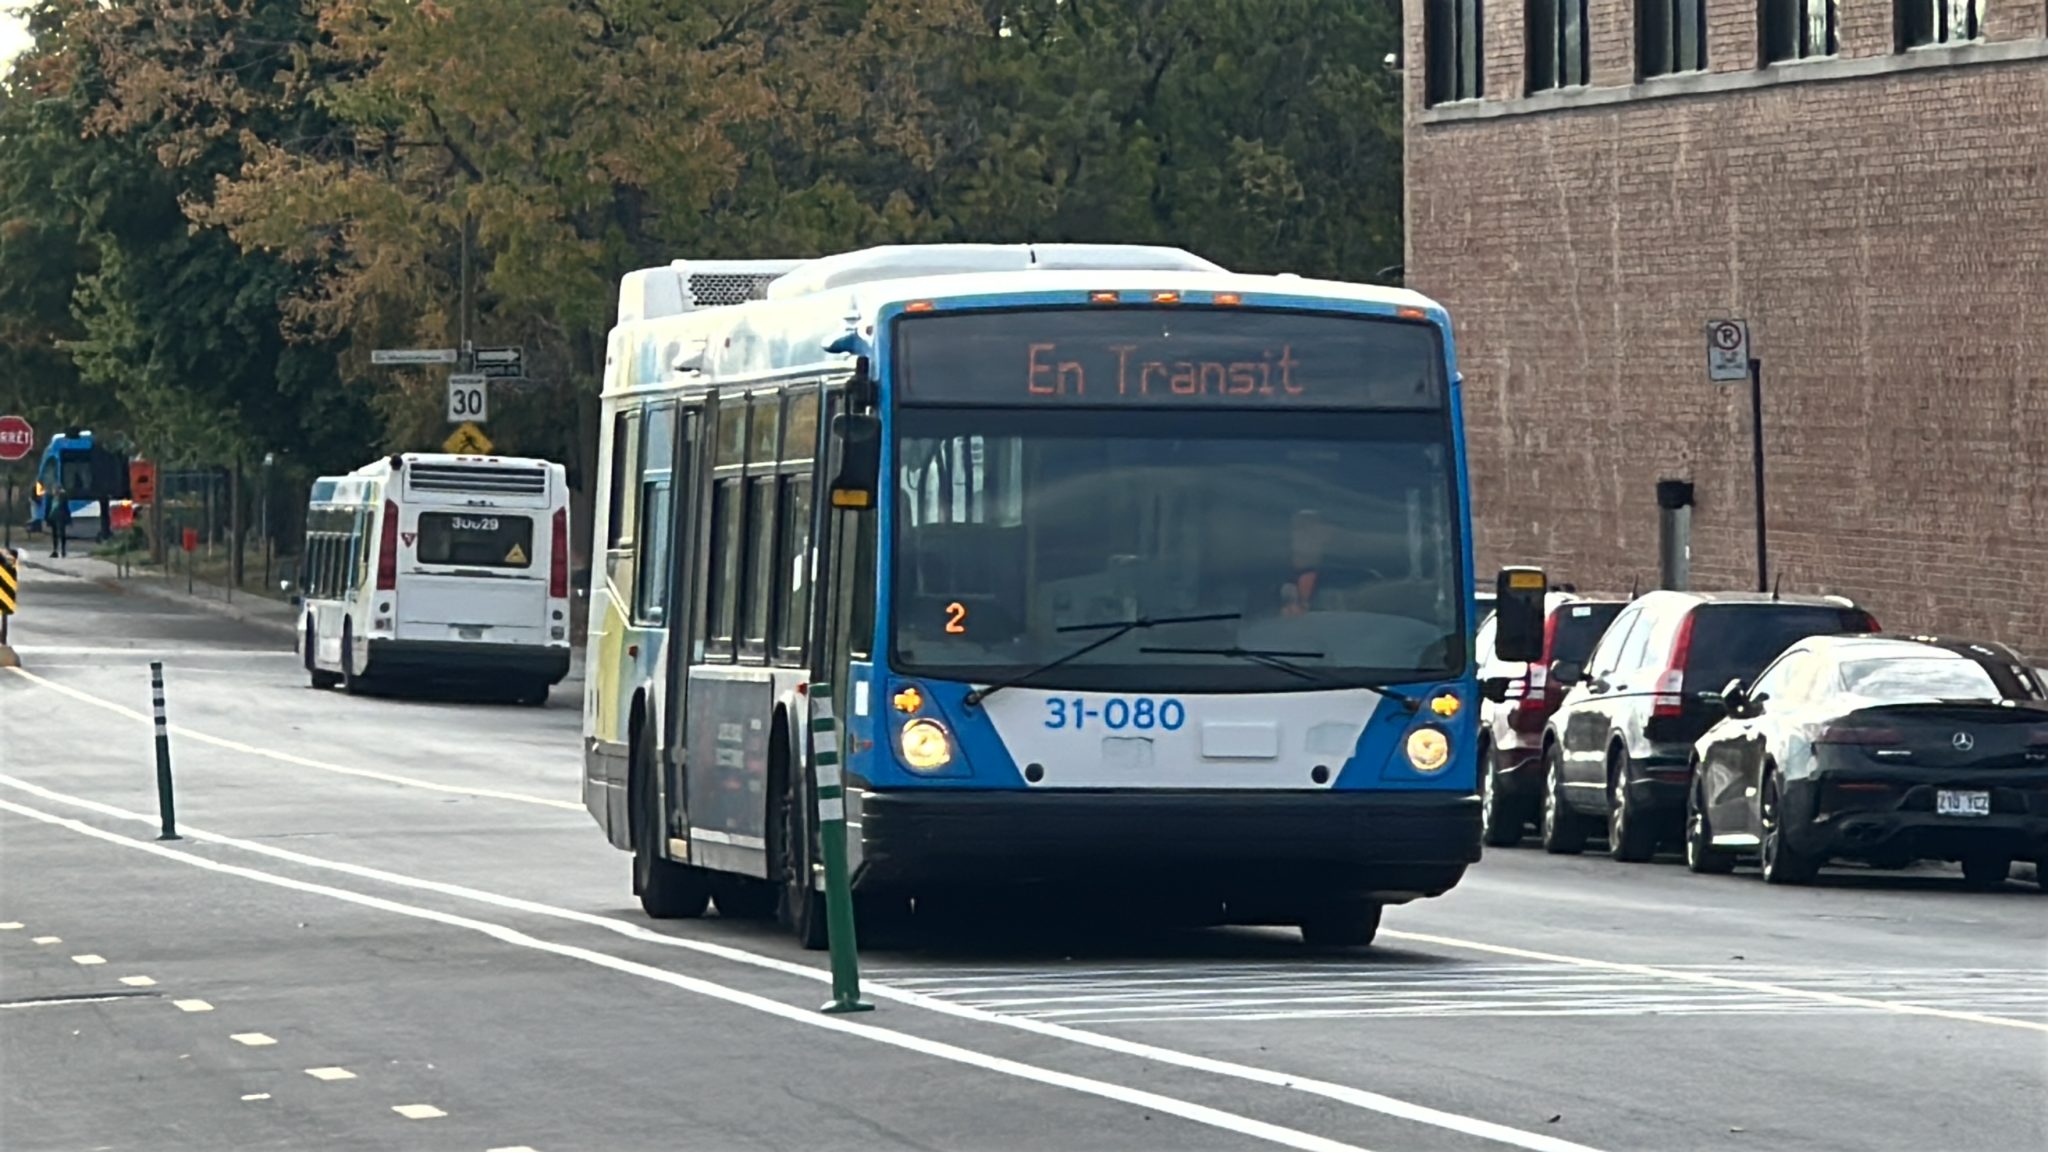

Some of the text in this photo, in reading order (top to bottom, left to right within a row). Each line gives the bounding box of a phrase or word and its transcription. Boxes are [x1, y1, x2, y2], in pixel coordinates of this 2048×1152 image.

[1028, 343, 1303, 395] En Transit
[453, 389, 483, 415] 30
[0, 430, 29, 444] RRÊT
[944, 602, 965, 633] 2
[1044, 698, 1186, 731] 31-080
